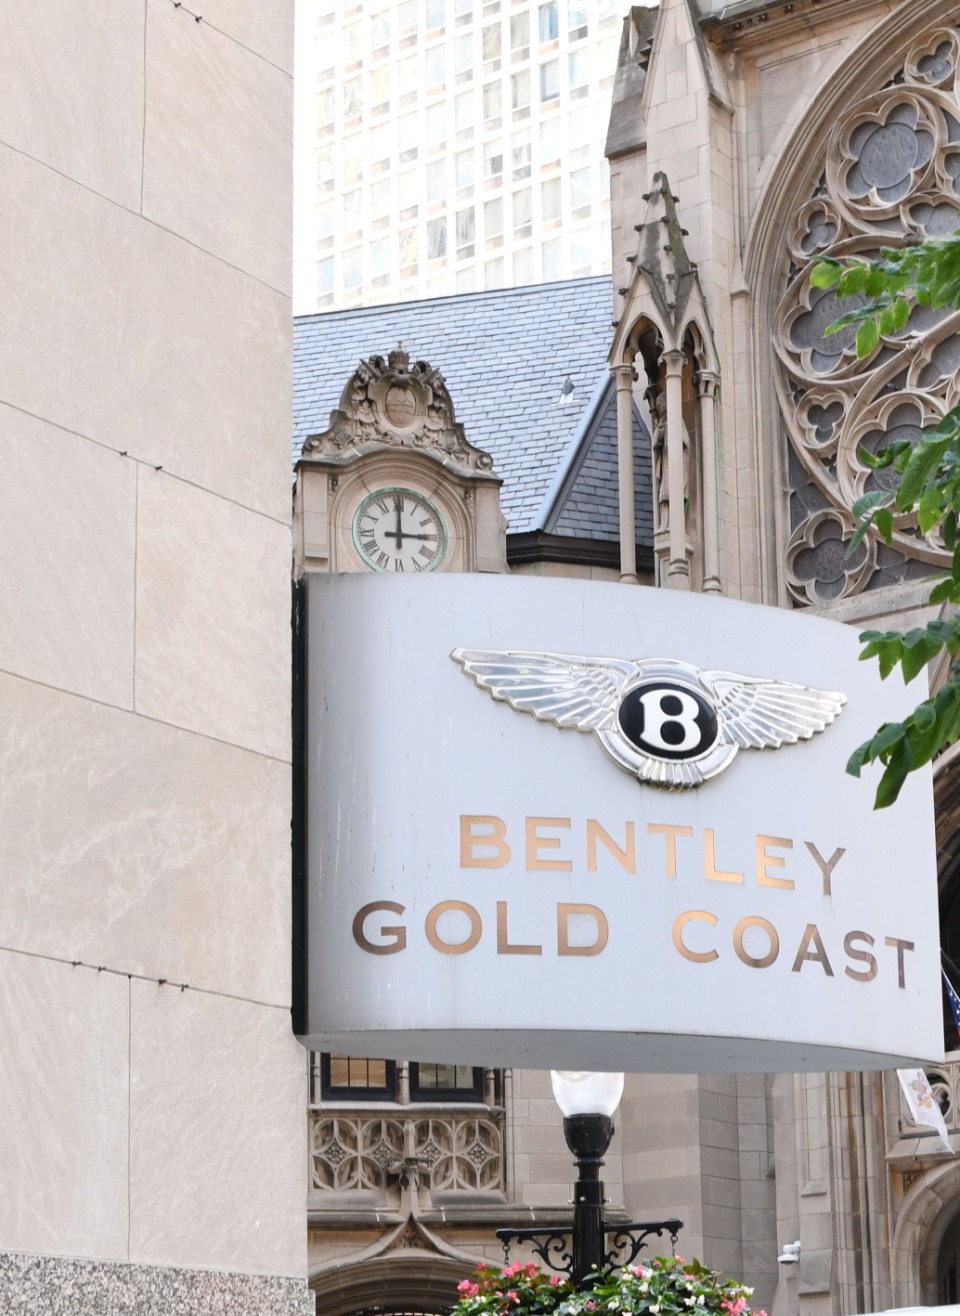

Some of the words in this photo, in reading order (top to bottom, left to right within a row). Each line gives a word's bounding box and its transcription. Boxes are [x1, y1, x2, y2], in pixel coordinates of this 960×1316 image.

[639, 688, 701, 753] B
[458, 814, 847, 896] BENTLEY
[352, 899, 610, 957] GOLD
[671, 909, 915, 989] COAST
